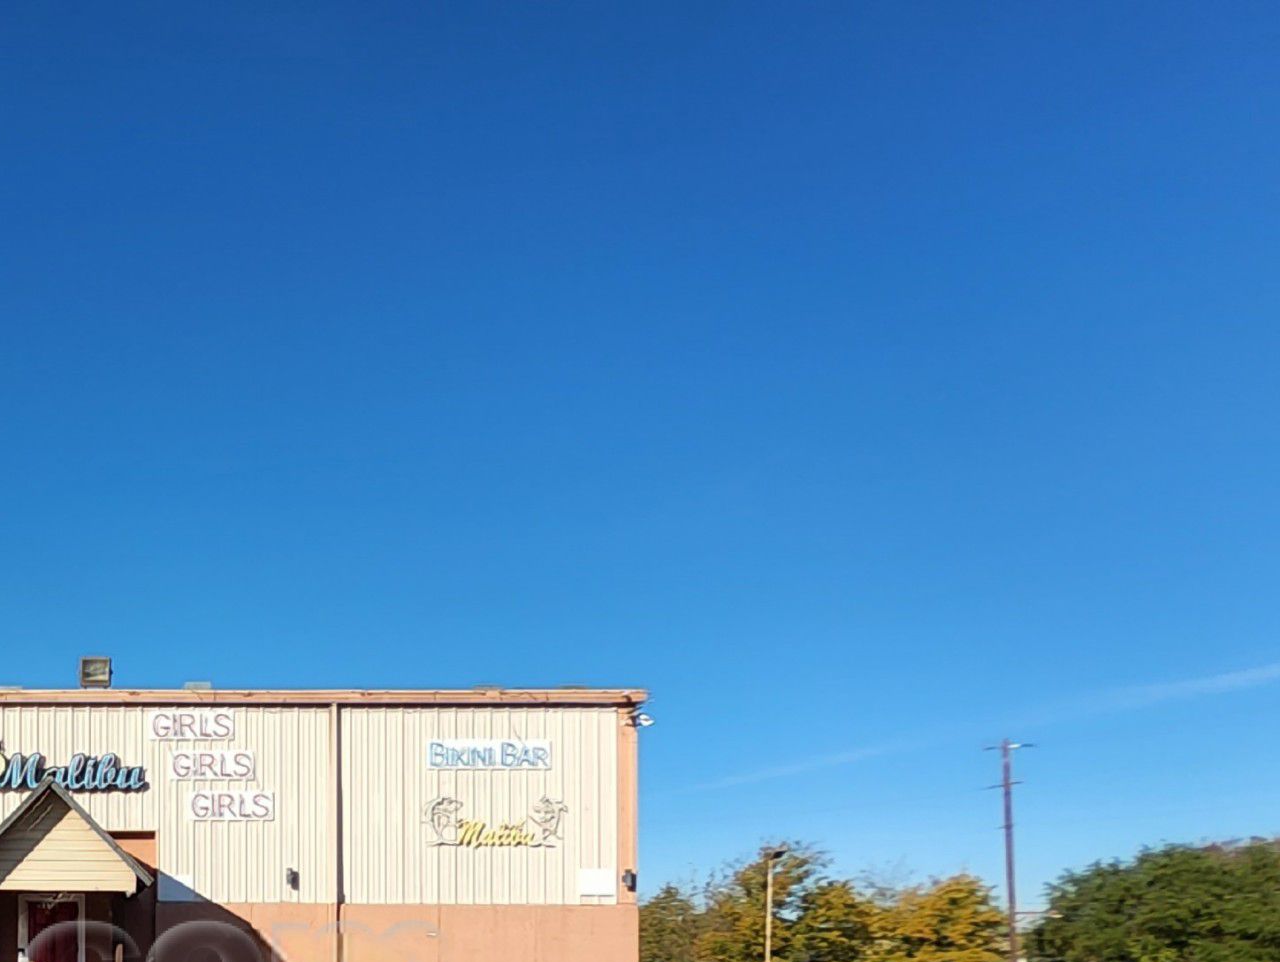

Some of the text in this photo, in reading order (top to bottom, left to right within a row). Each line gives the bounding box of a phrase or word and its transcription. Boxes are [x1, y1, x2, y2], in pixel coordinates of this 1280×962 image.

[152, 713, 233, 738] GIRLS
[172, 753, 252, 778] GIRLS
[500, 742, 549, 767] BAR
[191, 793, 271, 818] GIRLS
